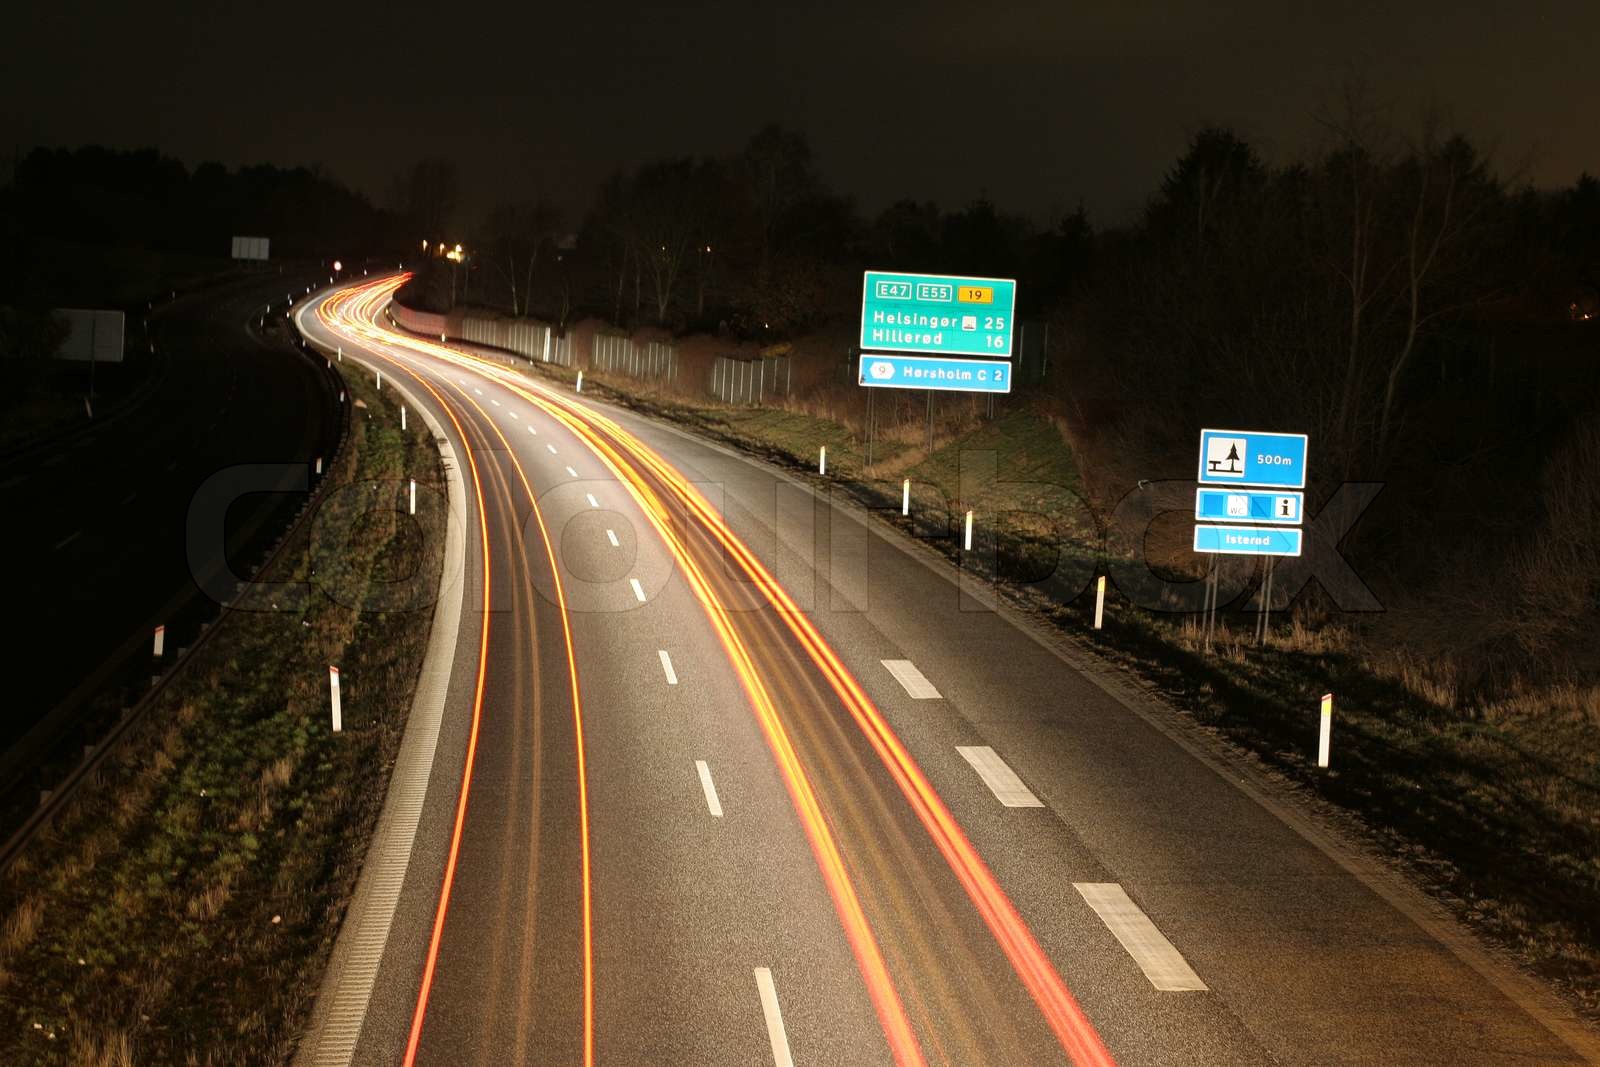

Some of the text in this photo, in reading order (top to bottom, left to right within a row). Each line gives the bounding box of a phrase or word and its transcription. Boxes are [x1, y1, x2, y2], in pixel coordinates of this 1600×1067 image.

[881, 284, 982, 300] E47 E55 19
[873, 310, 1005, 330] Helsingør 25
[872, 328, 1004, 348] Hillerød 16
[878, 365, 1003, 381] 9 Hørsholm C 2
[1257, 454, 1292, 466] 500m
[1230, 507, 1244, 515] WC
